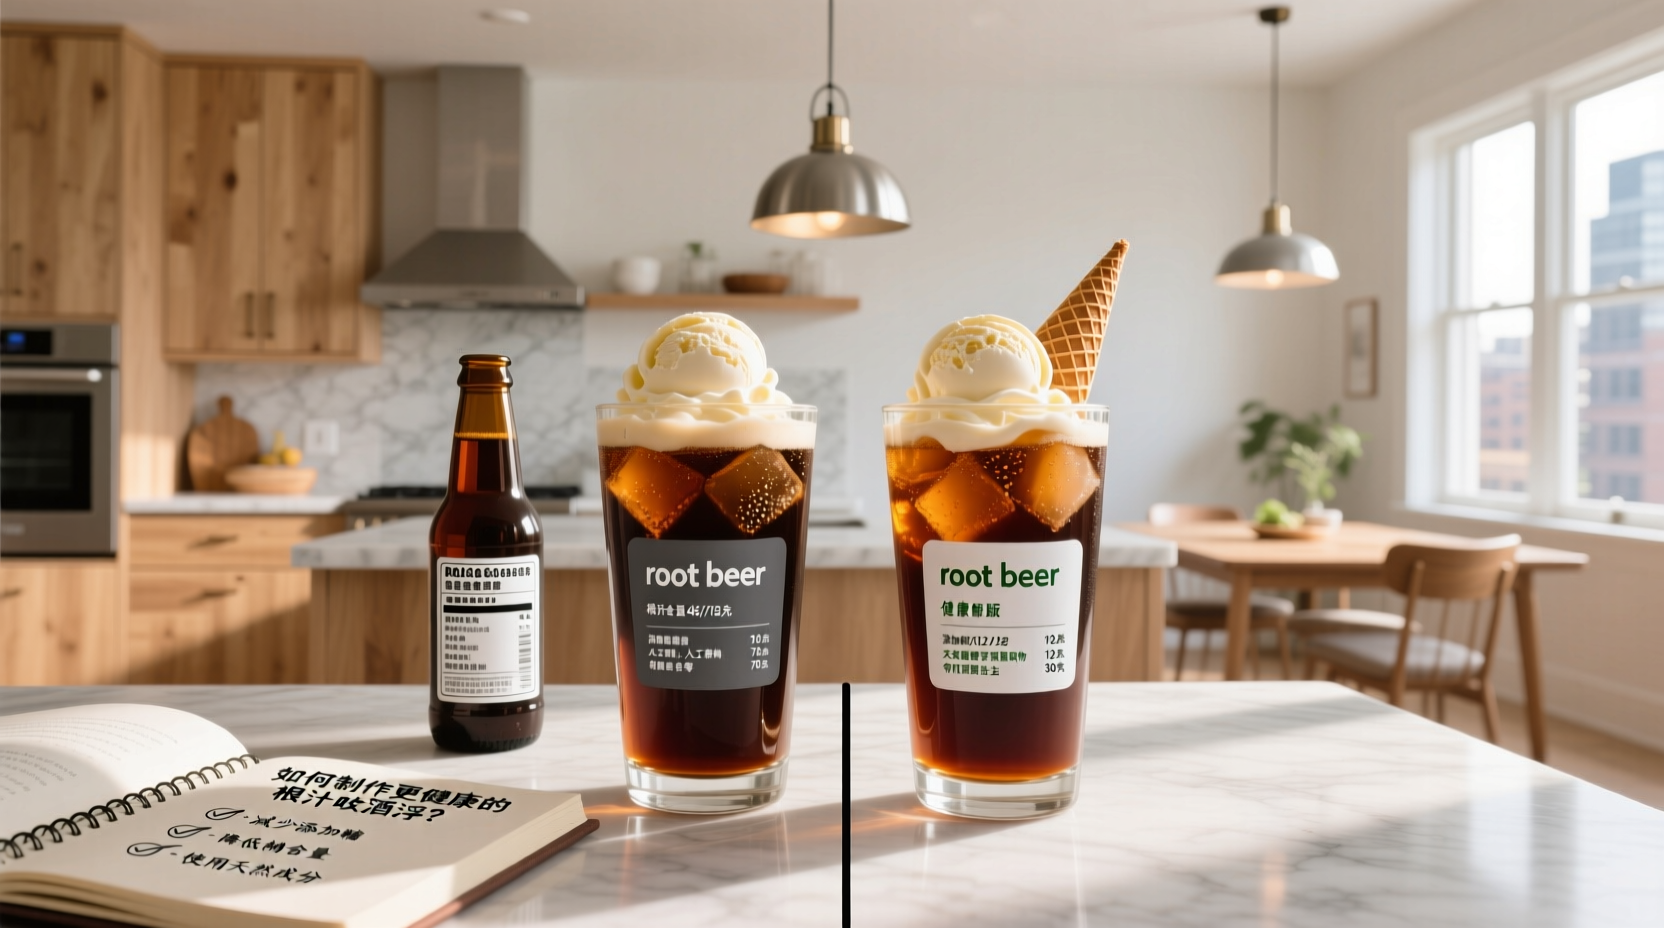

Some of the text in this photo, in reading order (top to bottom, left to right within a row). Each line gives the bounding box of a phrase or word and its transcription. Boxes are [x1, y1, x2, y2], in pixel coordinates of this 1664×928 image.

[646, 560, 767, 587] root beer
[940, 561, 1060, 588] root beer
[271, 766, 512, 813] 如何制作更健康的
